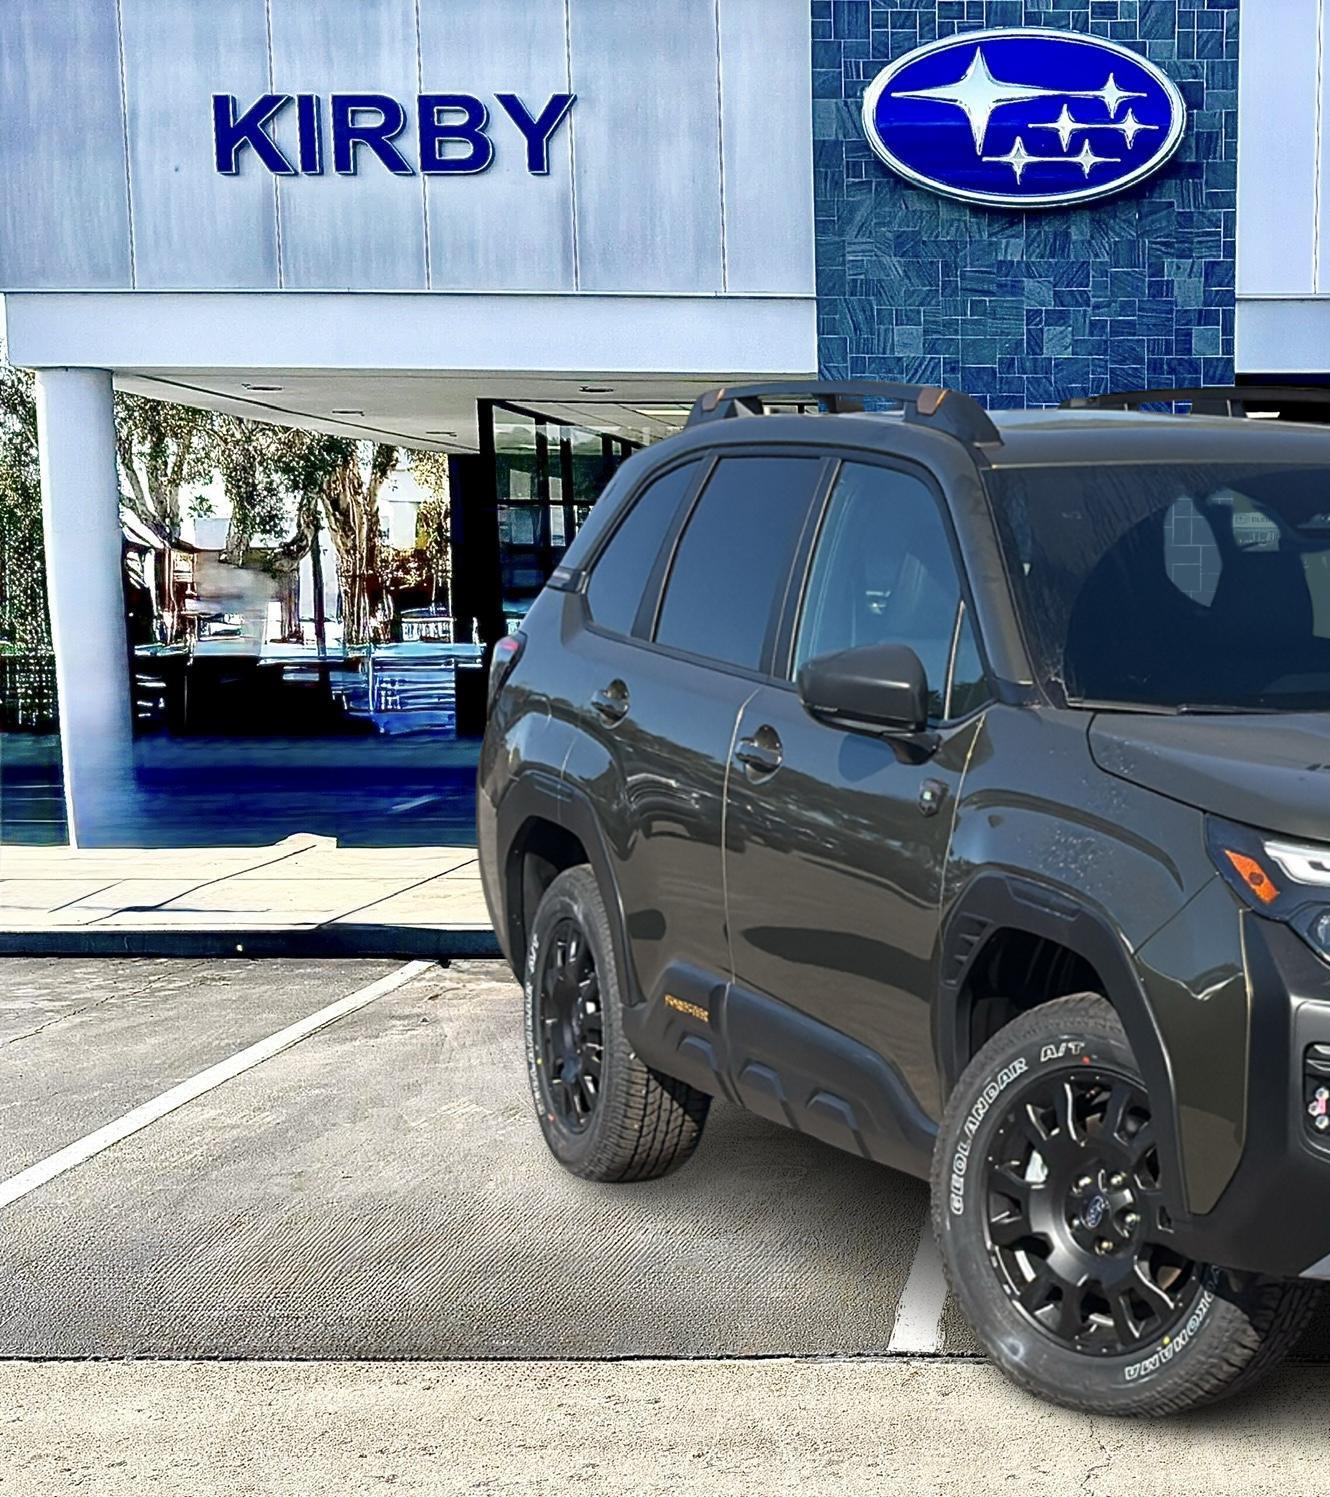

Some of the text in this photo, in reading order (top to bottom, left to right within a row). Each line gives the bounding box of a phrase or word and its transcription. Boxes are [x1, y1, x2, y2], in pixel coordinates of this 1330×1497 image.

[211, 93, 577, 176] KIRBY
[950, 1040, 1086, 1216] GEOLANDAR A/T
